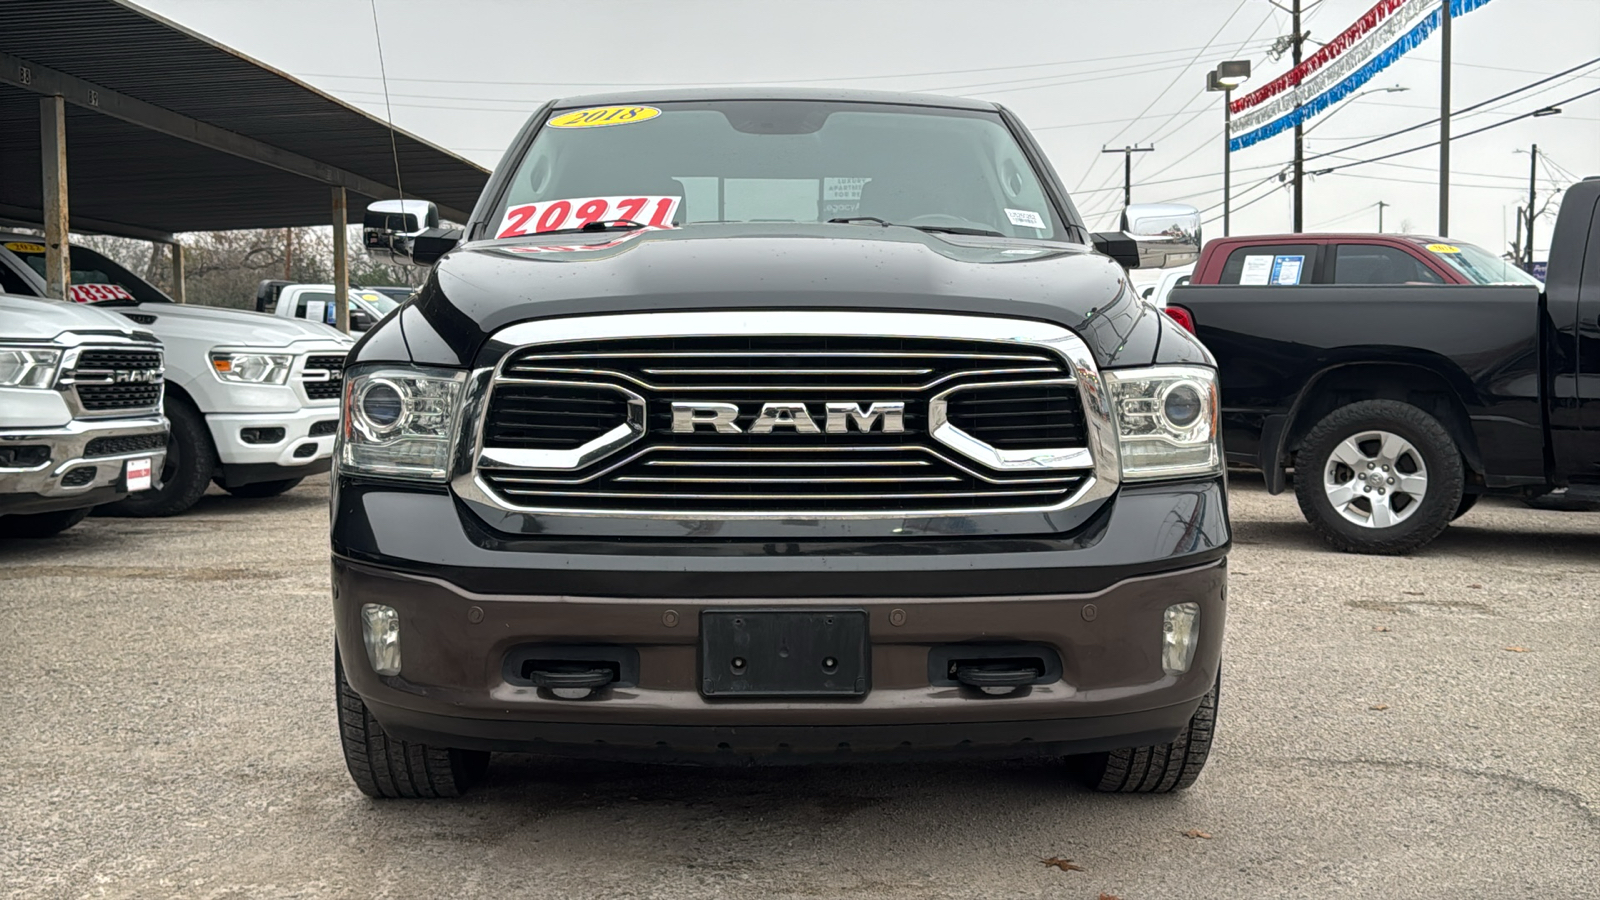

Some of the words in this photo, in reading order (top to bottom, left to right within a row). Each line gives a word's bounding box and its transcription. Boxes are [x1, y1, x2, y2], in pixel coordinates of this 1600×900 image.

[563, 107, 644, 125] 2018
[496, 197, 677, 238] 20971
[71, 285, 132, 303] 28395
[671, 401, 905, 434] RAM
